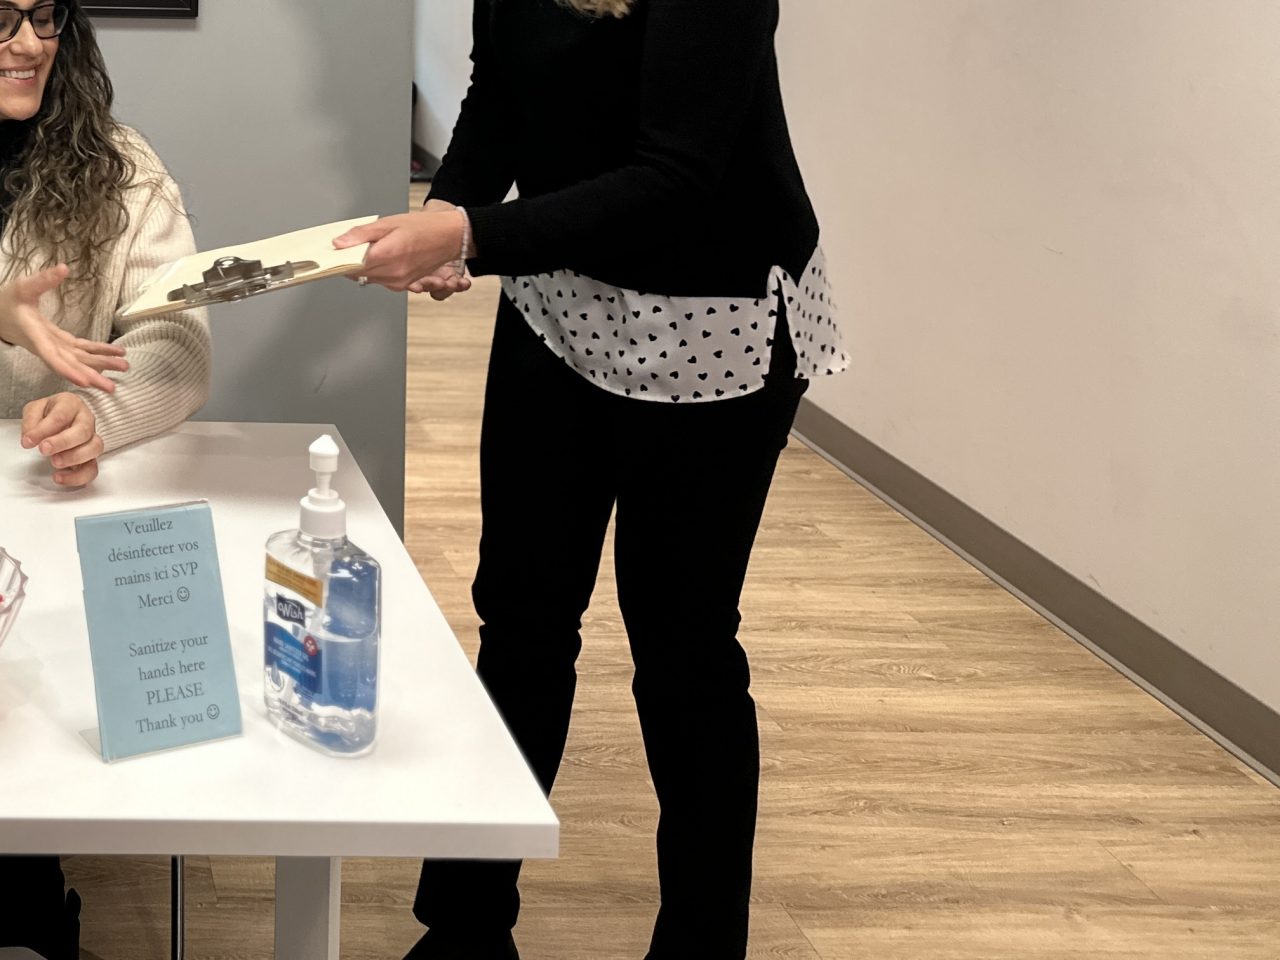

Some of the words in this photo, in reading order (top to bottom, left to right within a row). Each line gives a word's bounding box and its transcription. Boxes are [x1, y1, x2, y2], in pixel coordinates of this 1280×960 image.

[123, 517, 174, 535] Veuillez
[108, 543, 175, 563] désinfecter
[178, 540, 200, 554] vos
[114, 569, 152, 588] mains
[154, 565, 170, 582] ici
[171, 562, 199, 579] SVP
[137, 593, 175, 609] Merci
[128, 639, 179, 658] Sanitize
[179, 634, 209, 653] your
[138, 664, 176, 682] hands
[178, 659, 206, 675] here
[146, 681, 205, 706] PLEASE
[135, 715, 178, 734] Thank
[179, 711, 204, 731] you
